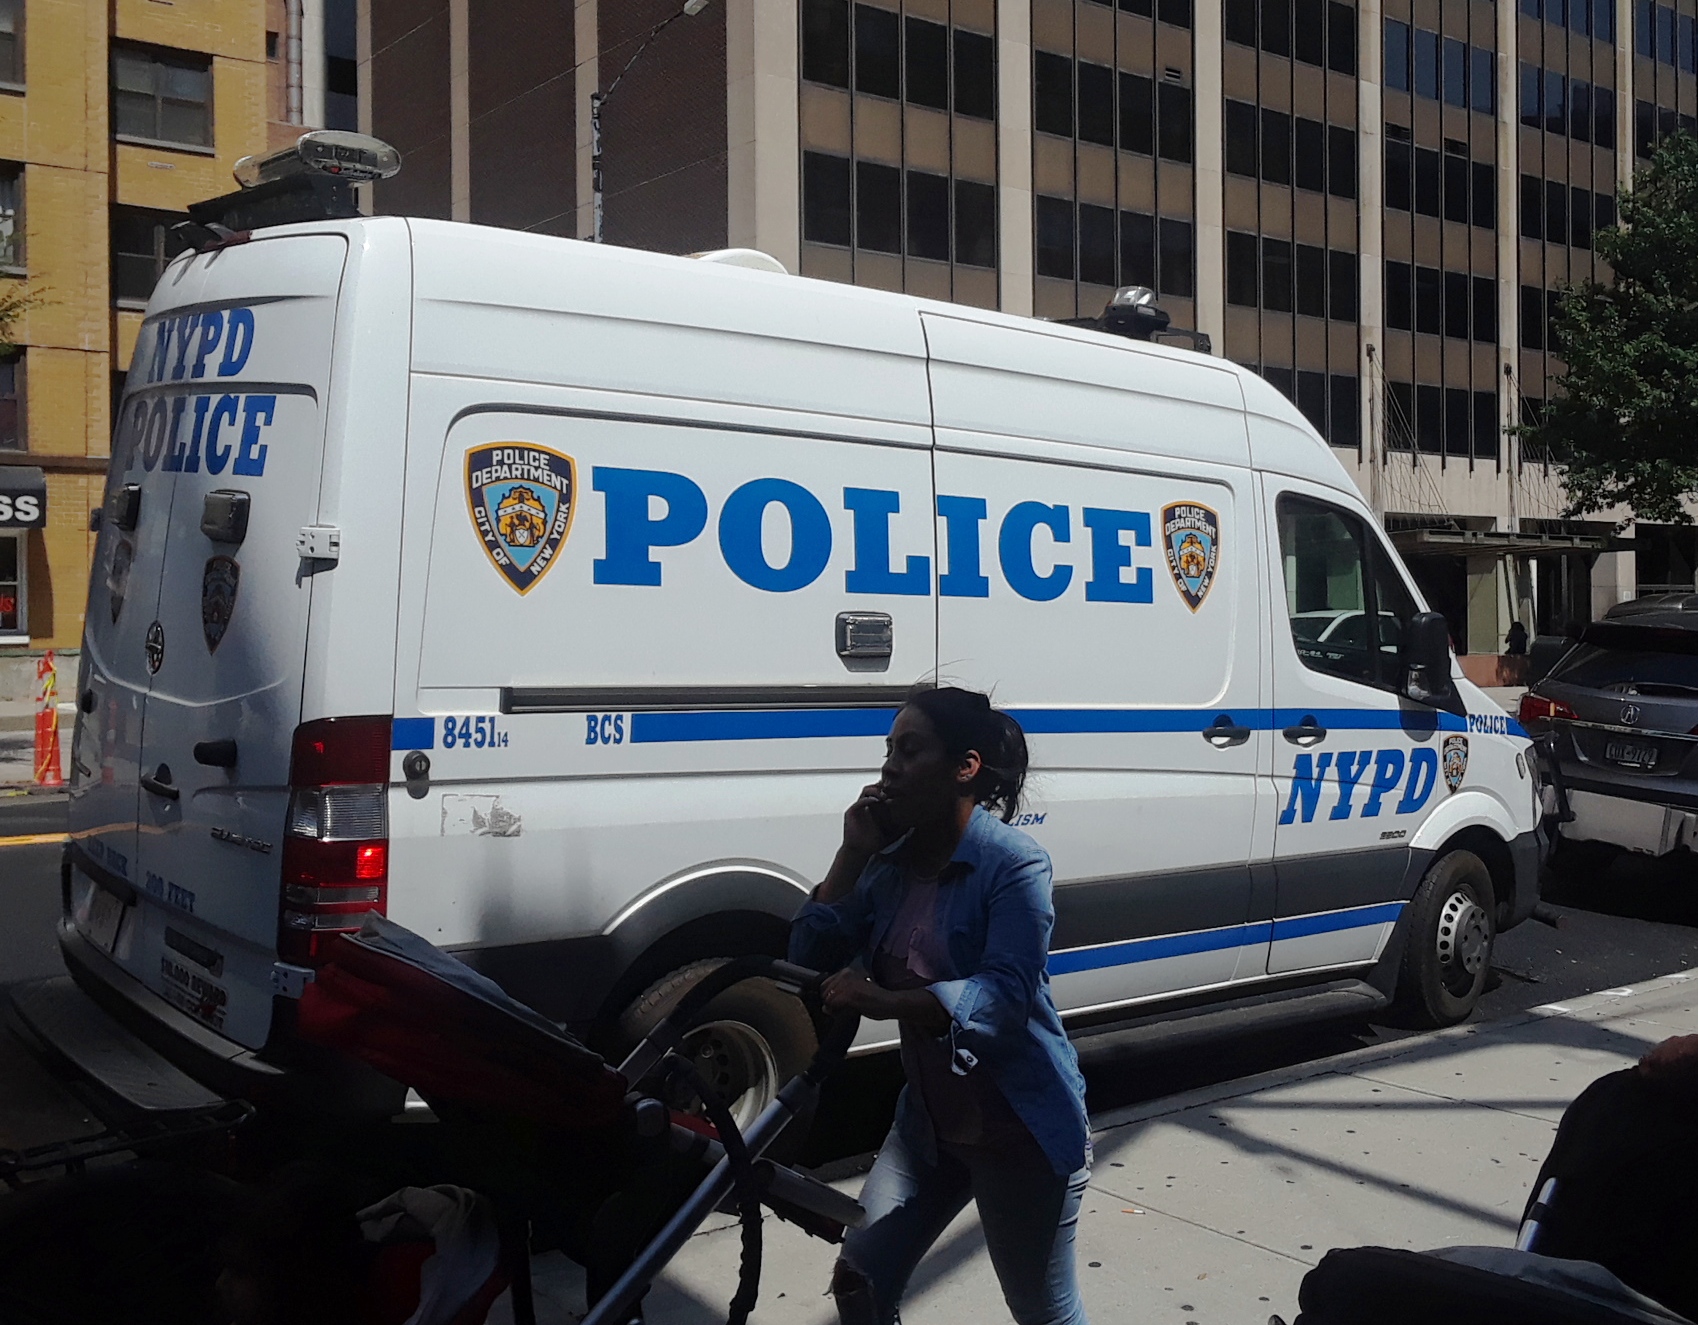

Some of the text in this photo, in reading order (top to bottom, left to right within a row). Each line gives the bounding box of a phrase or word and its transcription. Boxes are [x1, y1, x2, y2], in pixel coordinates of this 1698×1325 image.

[148, 308, 255, 384] NYPD
[124, 394, 277, 477] POLICE
[472, 465, 570, 493] DEPARTMENT
[492, 449, 550, 470] POLICE
[592, 465, 1154, 604] POLICE
[1165, 518, 1216, 539] DEPARTMENT
[1175, 506, 1206, 521] POLICE
[474, 506, 510, 566] CITY OF
[529, 502, 570, 575] NEW YORK
[1167, 548, 1188, 592] CITY OF
[1196, 545, 1217, 598] NEW YORK
[443, 716, 509, 749] 8451 14
[585, 714, 625, 746] BCS
[1468, 713, 1506, 735] POLICE
[1278, 747, 1438, 826] NYPD
